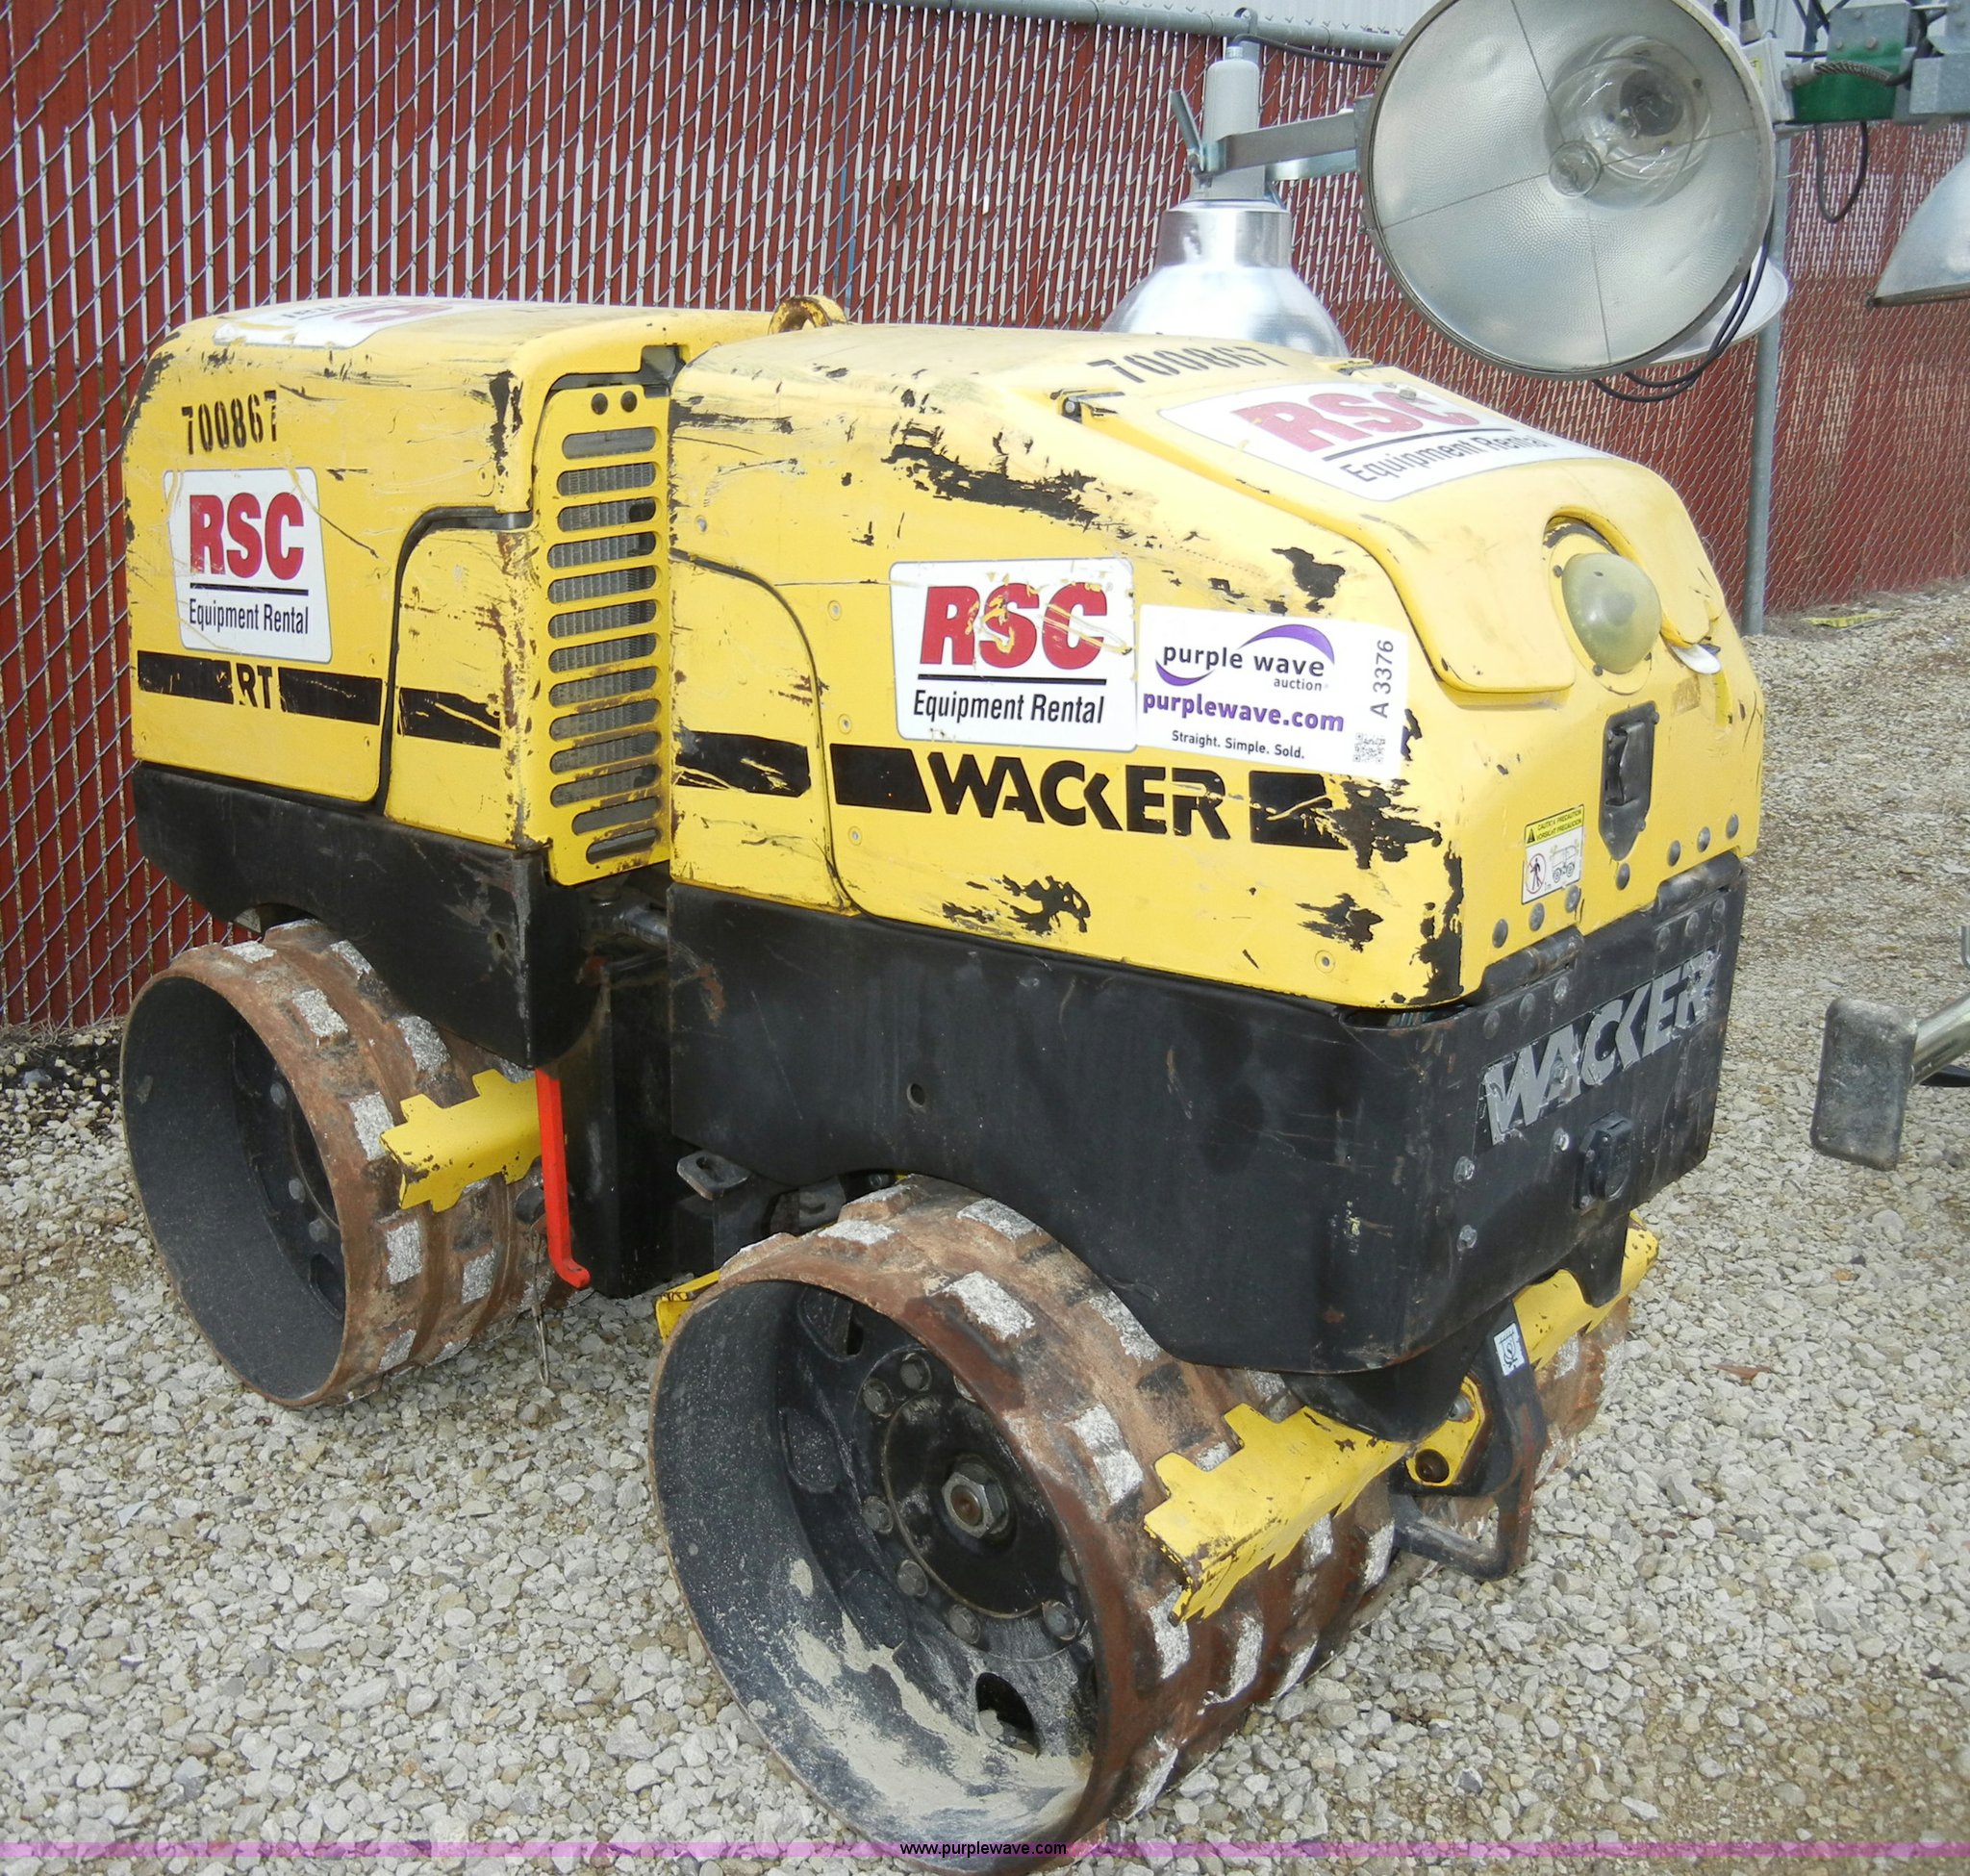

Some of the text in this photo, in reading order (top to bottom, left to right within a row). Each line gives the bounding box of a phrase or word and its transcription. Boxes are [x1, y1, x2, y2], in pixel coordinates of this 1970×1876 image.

[1086, 346, 1289, 383] 700867
[181, 390, 278, 455] 700867
[1231, 391, 1480, 452] RSC
[1339, 435, 1555, 482] Equipment Rental
[189, 492, 305, 580] RSC
[189, 597, 309, 637] Equipment Rental
[920, 581, 1107, 670] RSC
[1163, 646, 1325, 677] purple wave
[1274, 677, 1323, 692] auction
[1370, 640, 1395, 719] A 3376
[236, 662, 273, 709] RT
[914, 689, 1105, 724] Equipment Rental
[1143, 691, 1345, 732] purplewave.com
[1172, 729, 1305, 759] Straight. Simple. Sold.
[927, 751, 1231, 840] WACKER
[1482, 949, 1719, 1146] WACKER
